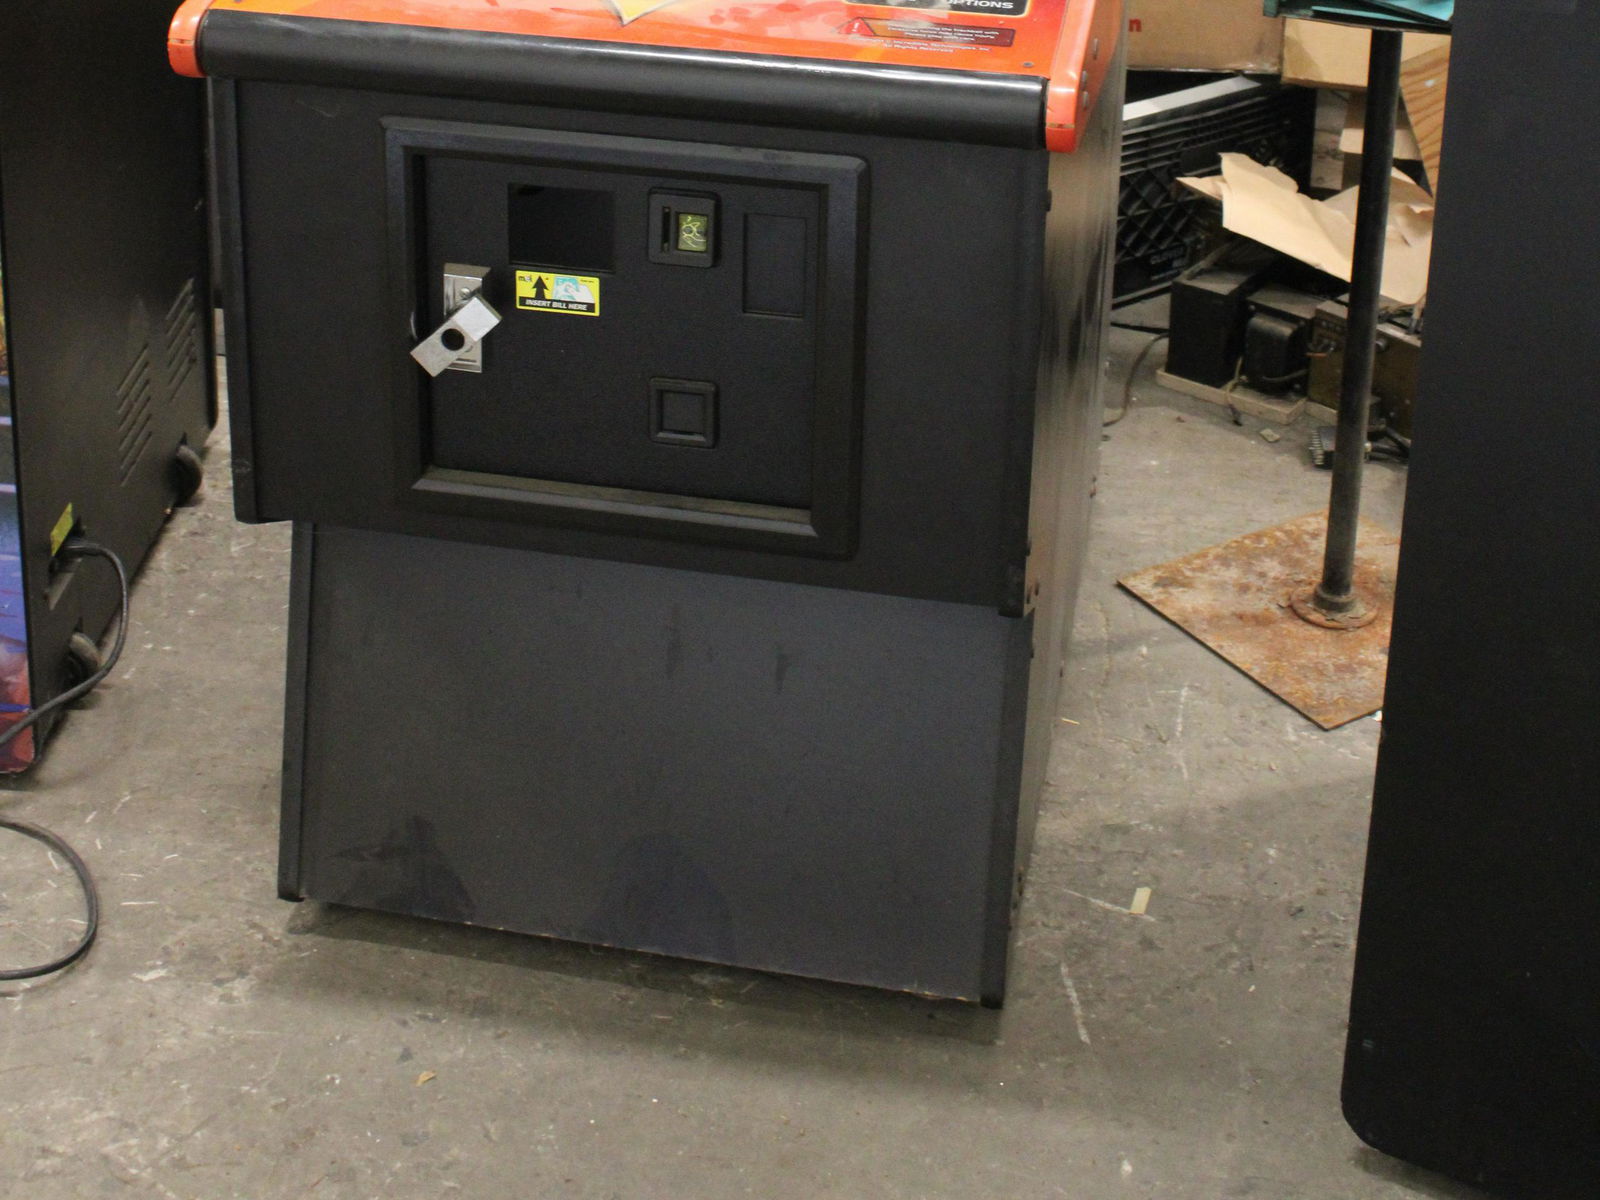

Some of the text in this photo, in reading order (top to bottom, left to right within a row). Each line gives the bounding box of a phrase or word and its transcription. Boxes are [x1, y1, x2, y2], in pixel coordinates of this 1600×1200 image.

[525, 298, 587, 311] INSERT BILL HERE
